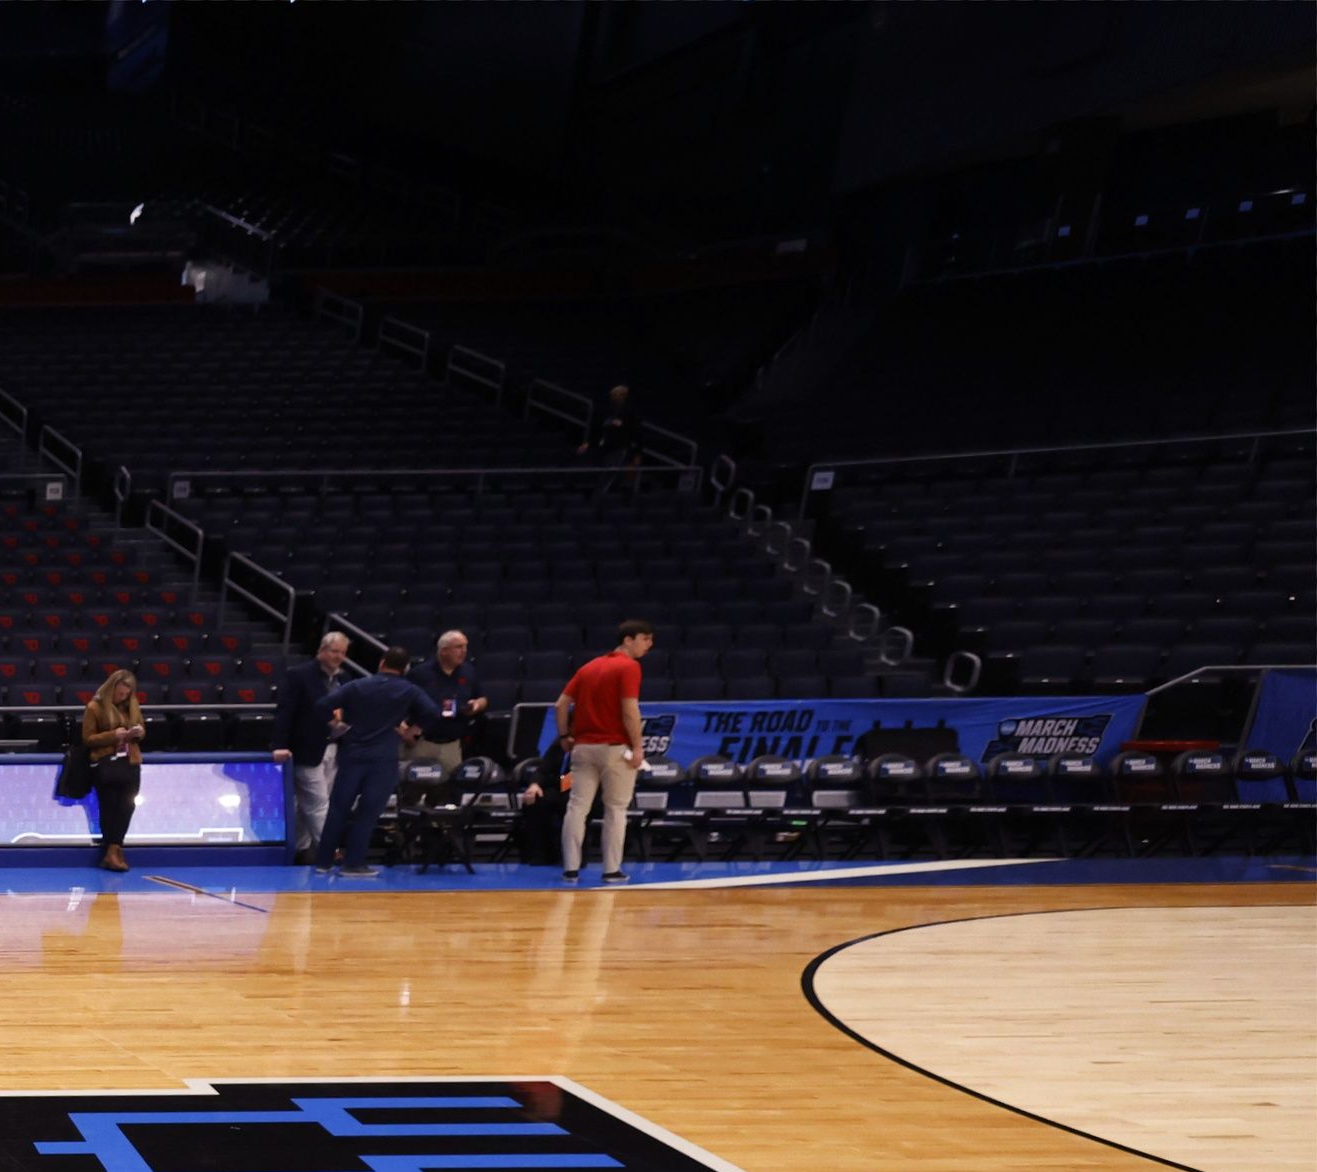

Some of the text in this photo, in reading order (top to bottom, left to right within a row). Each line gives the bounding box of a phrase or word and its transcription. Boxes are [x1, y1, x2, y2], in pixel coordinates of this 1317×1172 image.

[704, 711, 747, 733] THE
[750, 710, 814, 733] ROAD
[1015, 719, 1078, 736] MARCH
[1017, 736, 1101, 754] MADNESS
